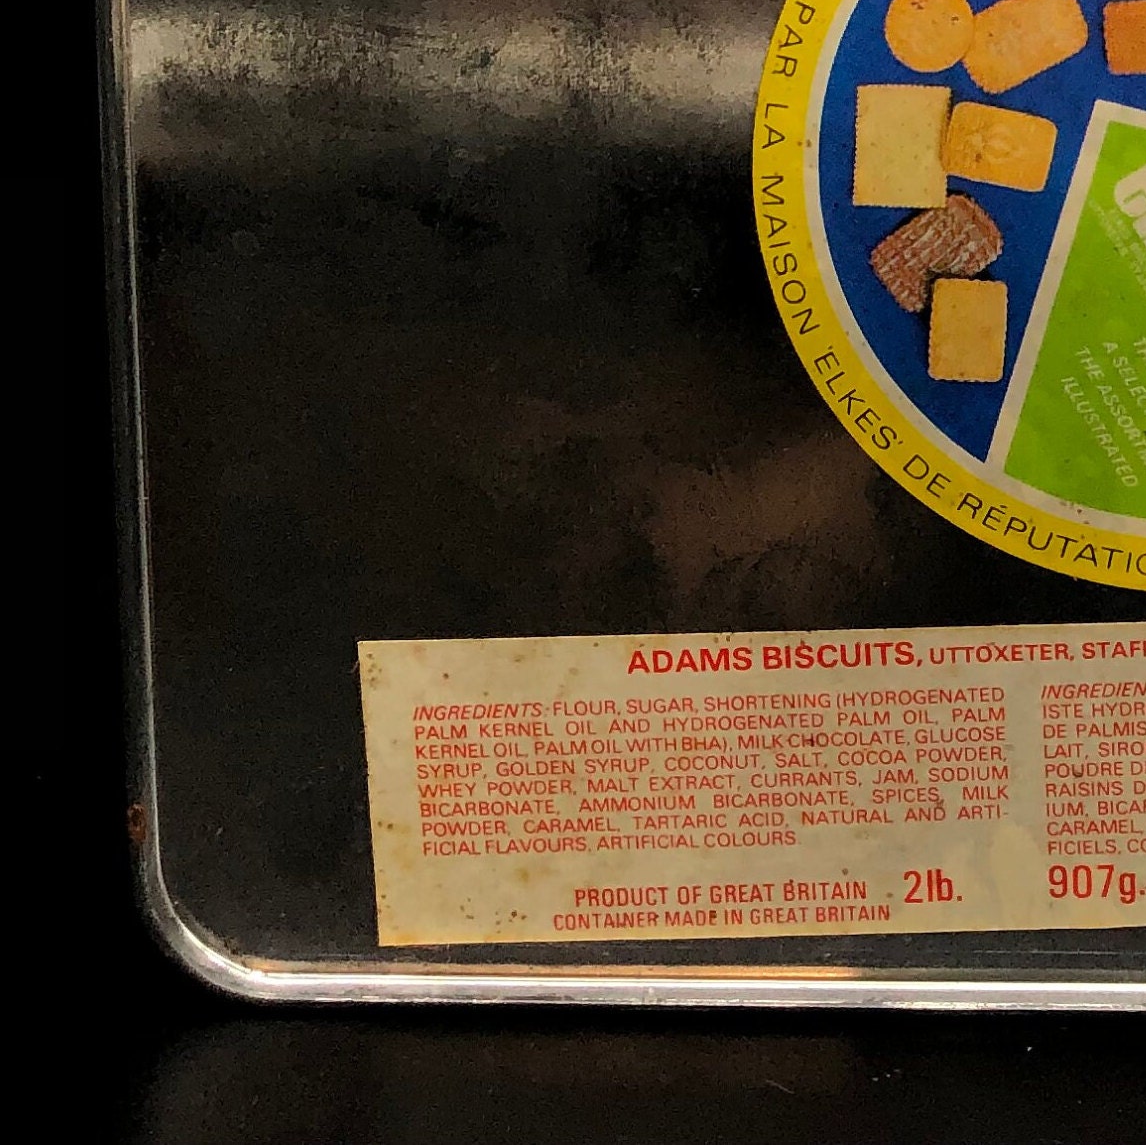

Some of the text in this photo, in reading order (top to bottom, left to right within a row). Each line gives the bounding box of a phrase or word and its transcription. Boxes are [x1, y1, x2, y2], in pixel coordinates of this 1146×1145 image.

[771, 0, 816, 78] PAR
[762, 102, 788, 149] LA
[761, 175, 821, 335] MAISON
[1075, 346, 1106, 382] THE
[1103, 342, 1119, 354] A
[1061, 377, 1138, 488] ILLUSTRATED
[902, 453, 952, 499] DE
[627, 647, 754, 674] ADAMS
[761, 642, 924, 670] BISCUITS,
[929, 642, 1075, 664] UTTOXETER,
[703, 692, 832, 712] SHORTENING
[836, 686, 1005, 708] (HYDROGENATED
[413, 706, 1006, 741] PALM KERNEL OIL AND HYDROGENATED PALM PALM
[415, 740, 489, 759] KERNEL
[534, 738, 587, 756] PALM
[590, 737, 622, 755] OIL
[626, 735, 677, 754] WITH
[738, 733, 784, 751] MILK
[915, 727, 1005, 746] GLUCOSE
[496, 760, 576, 777] GOLDEN
[837, 749, 907, 767] COCOA
[1045, 757, 1122, 777] POUDRE
[417, 782, 474, 799] WHEY
[587, 775, 637, 794] MALT
[929, 764, 1009, 783] SODIUM
[1045, 777, 1123, 796] RAISINS
[580, 795, 696, 812] AMMONIUM
[962, 784, 1010, 801] MILK
[634, 814, 726, 830] TARTARIC
[800, 808, 894, 826] NATURAL
[904, 804, 947, 823] AND
[956, 803, 1008, 821] ARTI-
[422, 840, 481, 857] FICIAL
[596, 834, 697, 850] ARTIFICIAL
[573, 881, 867, 907] PRODUCT OF GREAT BRITAIN
[903, 868, 964, 904] 2lb.
[1048, 864, 1146, 904] 907g.
[552, 905, 891, 931] CONTAINER MADE IN GREAT BRITAIN
